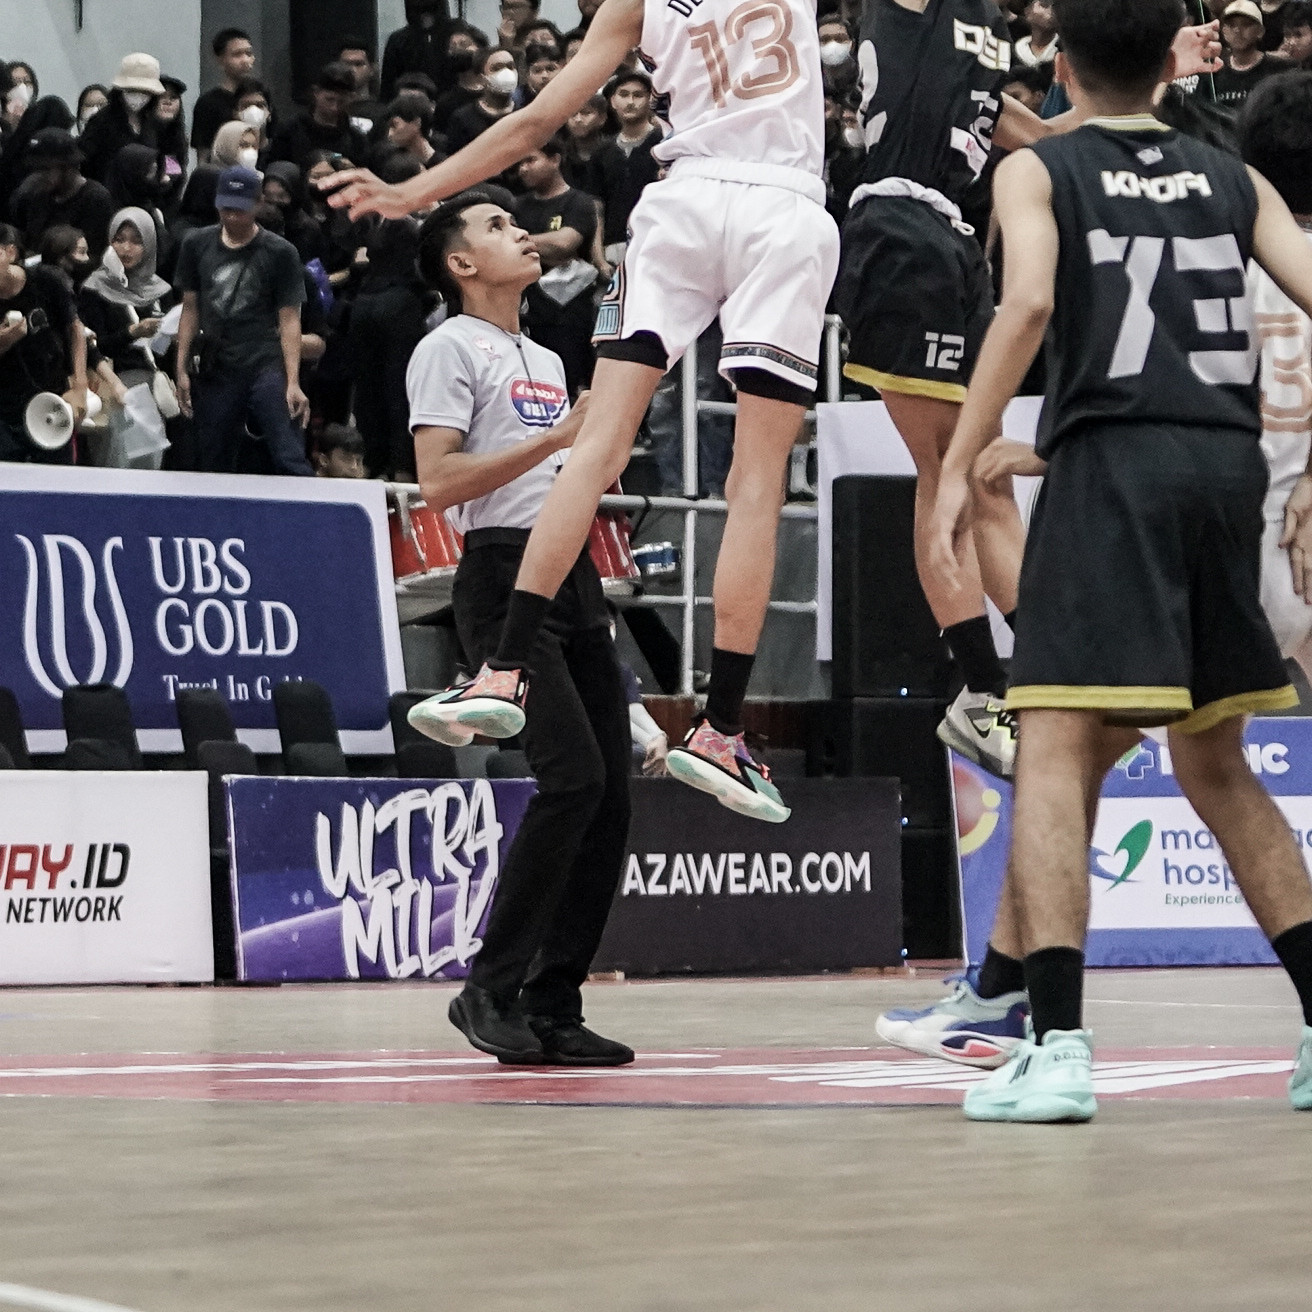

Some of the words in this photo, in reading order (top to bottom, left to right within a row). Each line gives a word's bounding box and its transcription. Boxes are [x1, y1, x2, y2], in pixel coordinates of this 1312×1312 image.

[925, 331, 965, 370] 12
[148, 536, 252, 595] UBS
[156, 597, 299, 657] GOLD
[226, 674, 250, 701] In
[316, 778, 504, 900] ULTRA
[623, 851, 872, 896] AZAWEAR.COM
[7, 895, 125, 925] NETWORK
[343, 873, 498, 979] MILK
